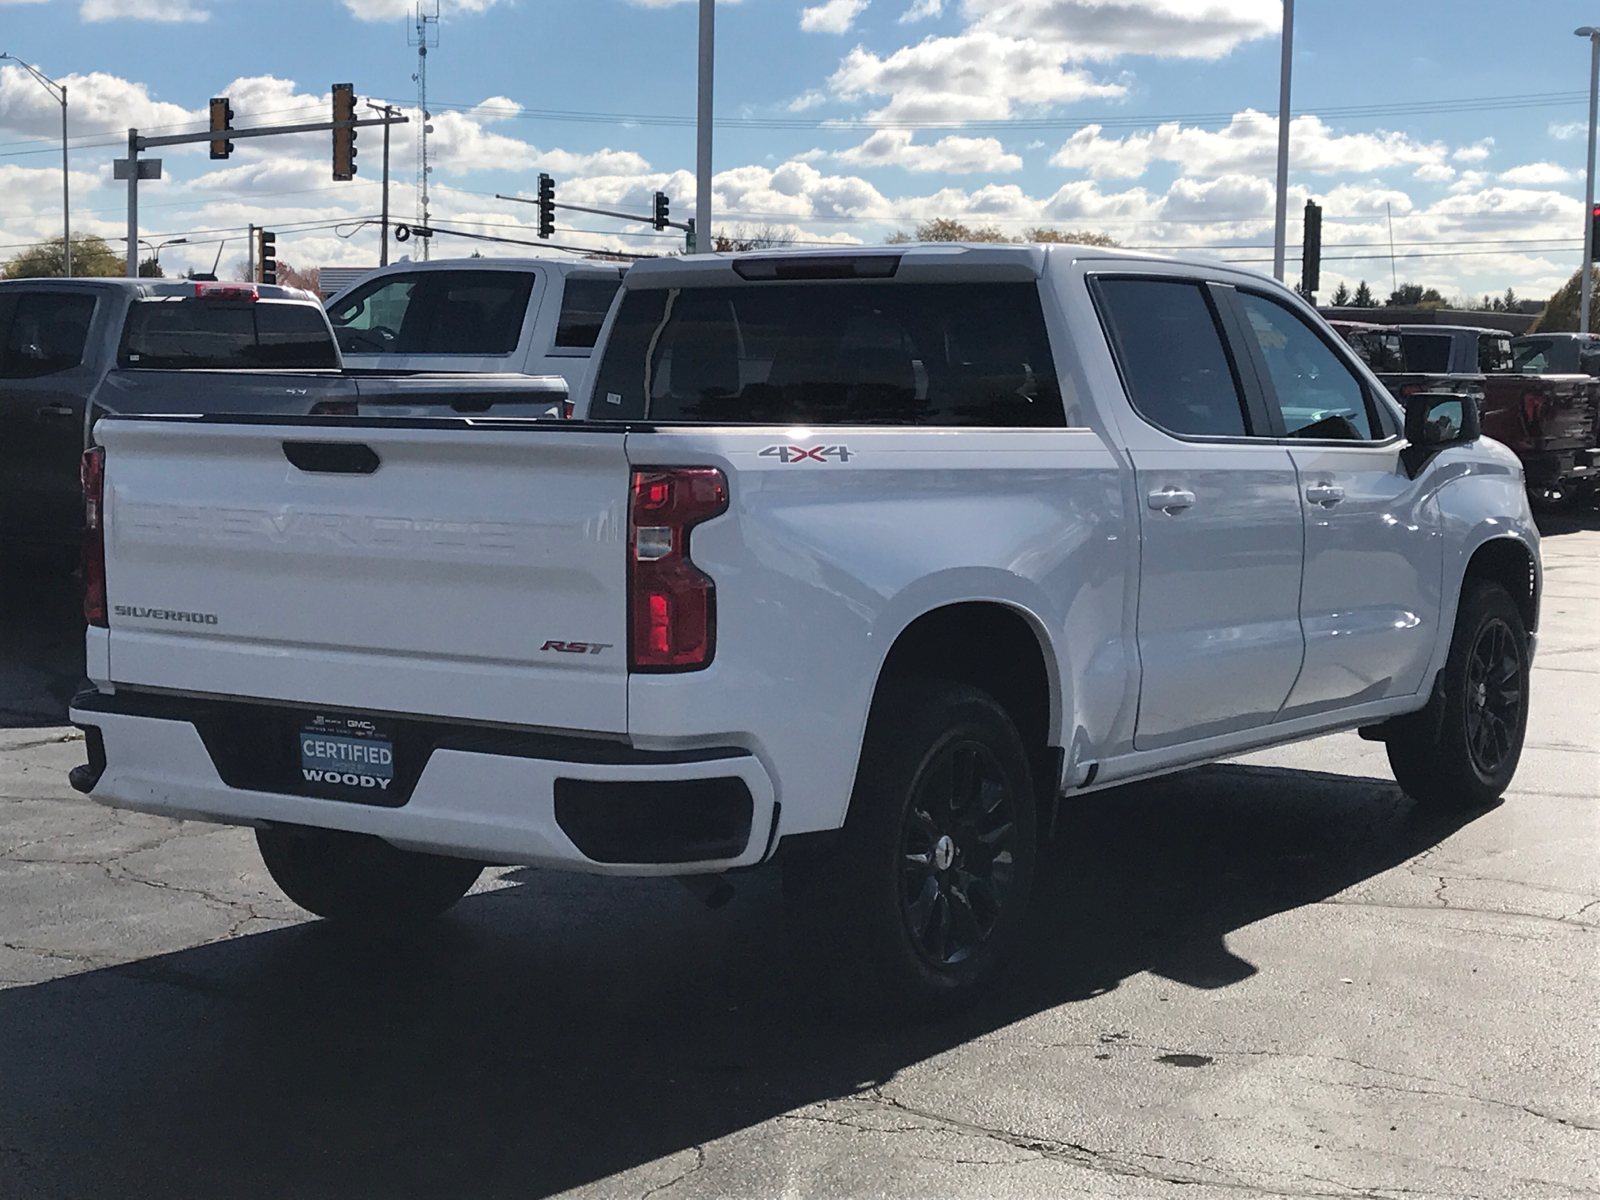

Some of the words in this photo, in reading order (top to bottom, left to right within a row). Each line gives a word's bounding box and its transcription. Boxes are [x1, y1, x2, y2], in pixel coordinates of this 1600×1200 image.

[114, 605, 218, 625] SILVERADO
[540, 640, 614, 655] RST
[347, 719, 371, 729] GMC
[303, 739, 392, 765] CERTIFIED
[302, 769, 391, 790] WOODY
